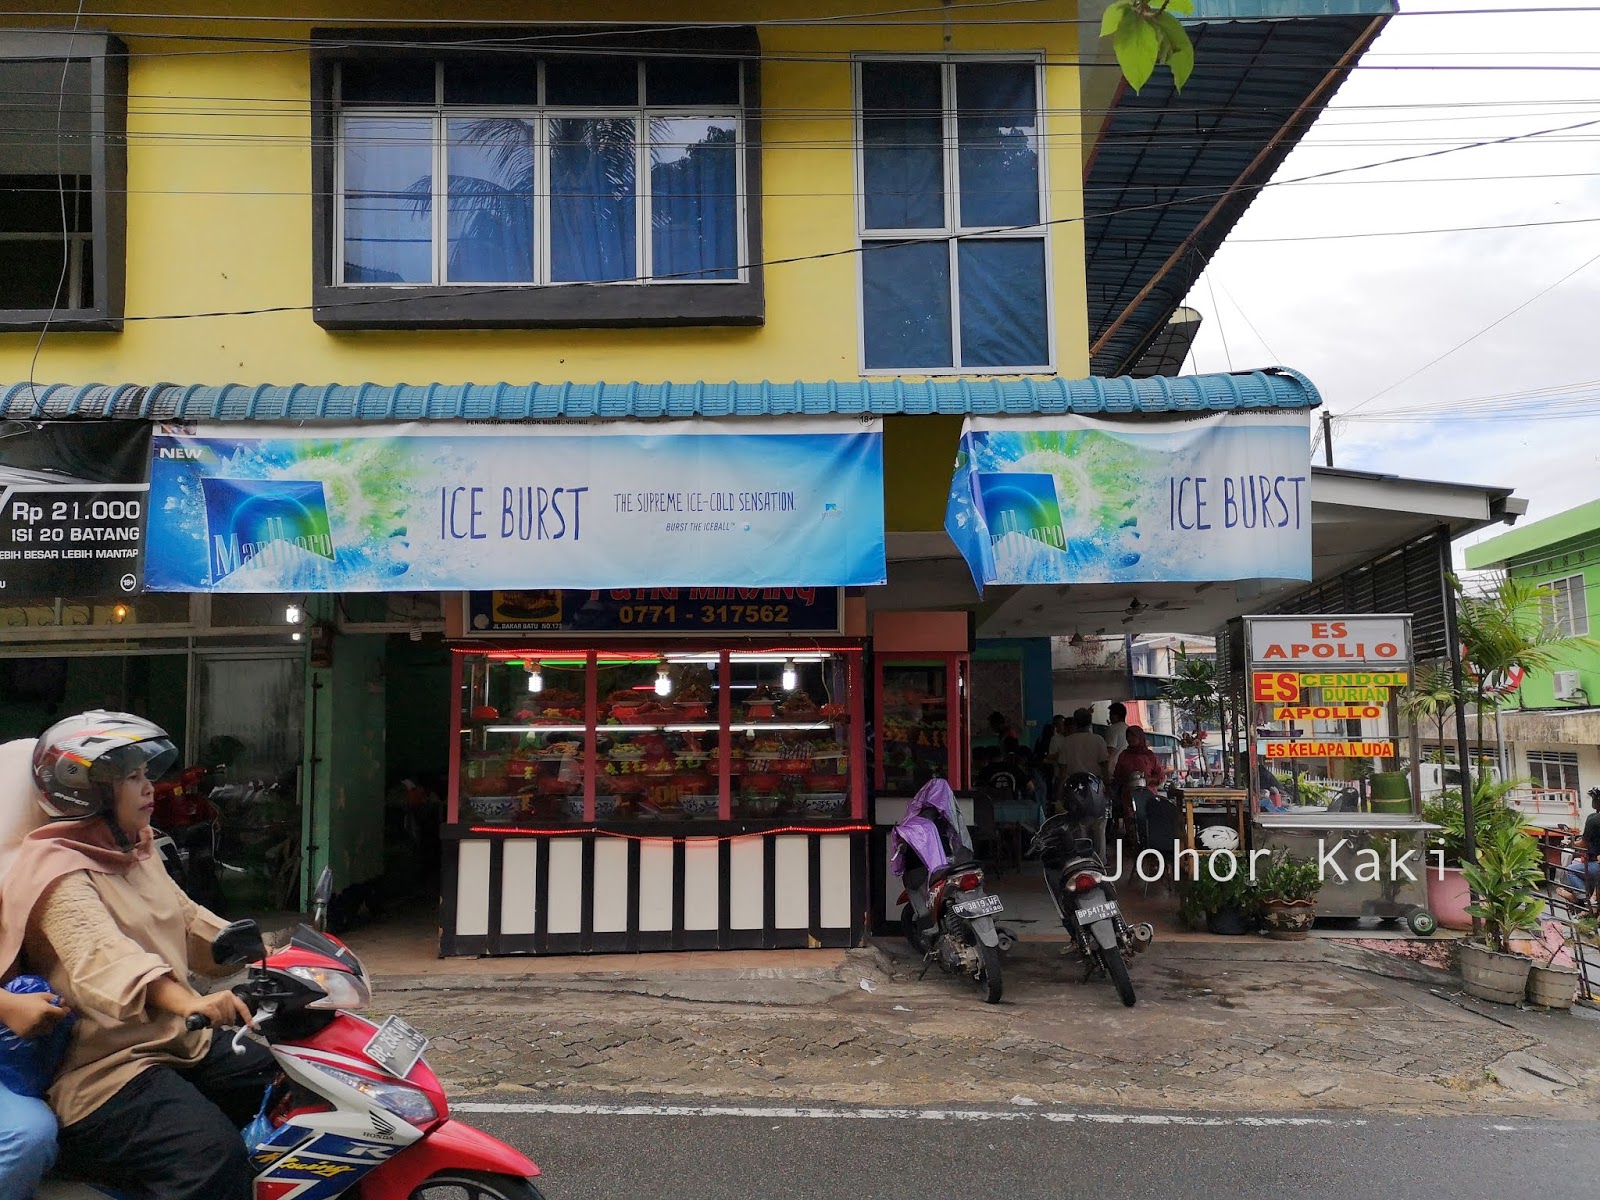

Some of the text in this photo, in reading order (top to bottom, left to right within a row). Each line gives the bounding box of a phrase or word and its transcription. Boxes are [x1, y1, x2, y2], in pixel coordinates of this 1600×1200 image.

[159, 447, 203, 459] NEW
[614, 491, 797, 512] THE SUPREME ICE-COLD SENSATION.
[1169, 475, 1306, 531] ICE BURST
[12, 501, 141, 525] Rp 21.000
[440, 486, 589, 541] ICE BURST
[666, 523, 688, 532] BURST
[690, 523, 702, 532] THE
[11, 528, 140, 542] ISI 20 BATANG
[0, 549, 139, 560] EBIH BESAR LEBIH MANTAP
[618, 605, 676, 624] 0771
[701, 604, 789, 623] 317562
[1311, 622, 1348, 639] ES
[1253, 673, 1407, 701] ES CENDOL
[1323, 688, 1388, 701] DURIAN
[1278, 706, 1380, 720] APOLLO
[1267, 743, 1285, 757] ES
[1289, 743, 1345, 756] KELAPA
[954, 905, 964, 913] BP
[1077, 909, 1087, 919] BP
[362, 1131, 395, 1142] HONDA
